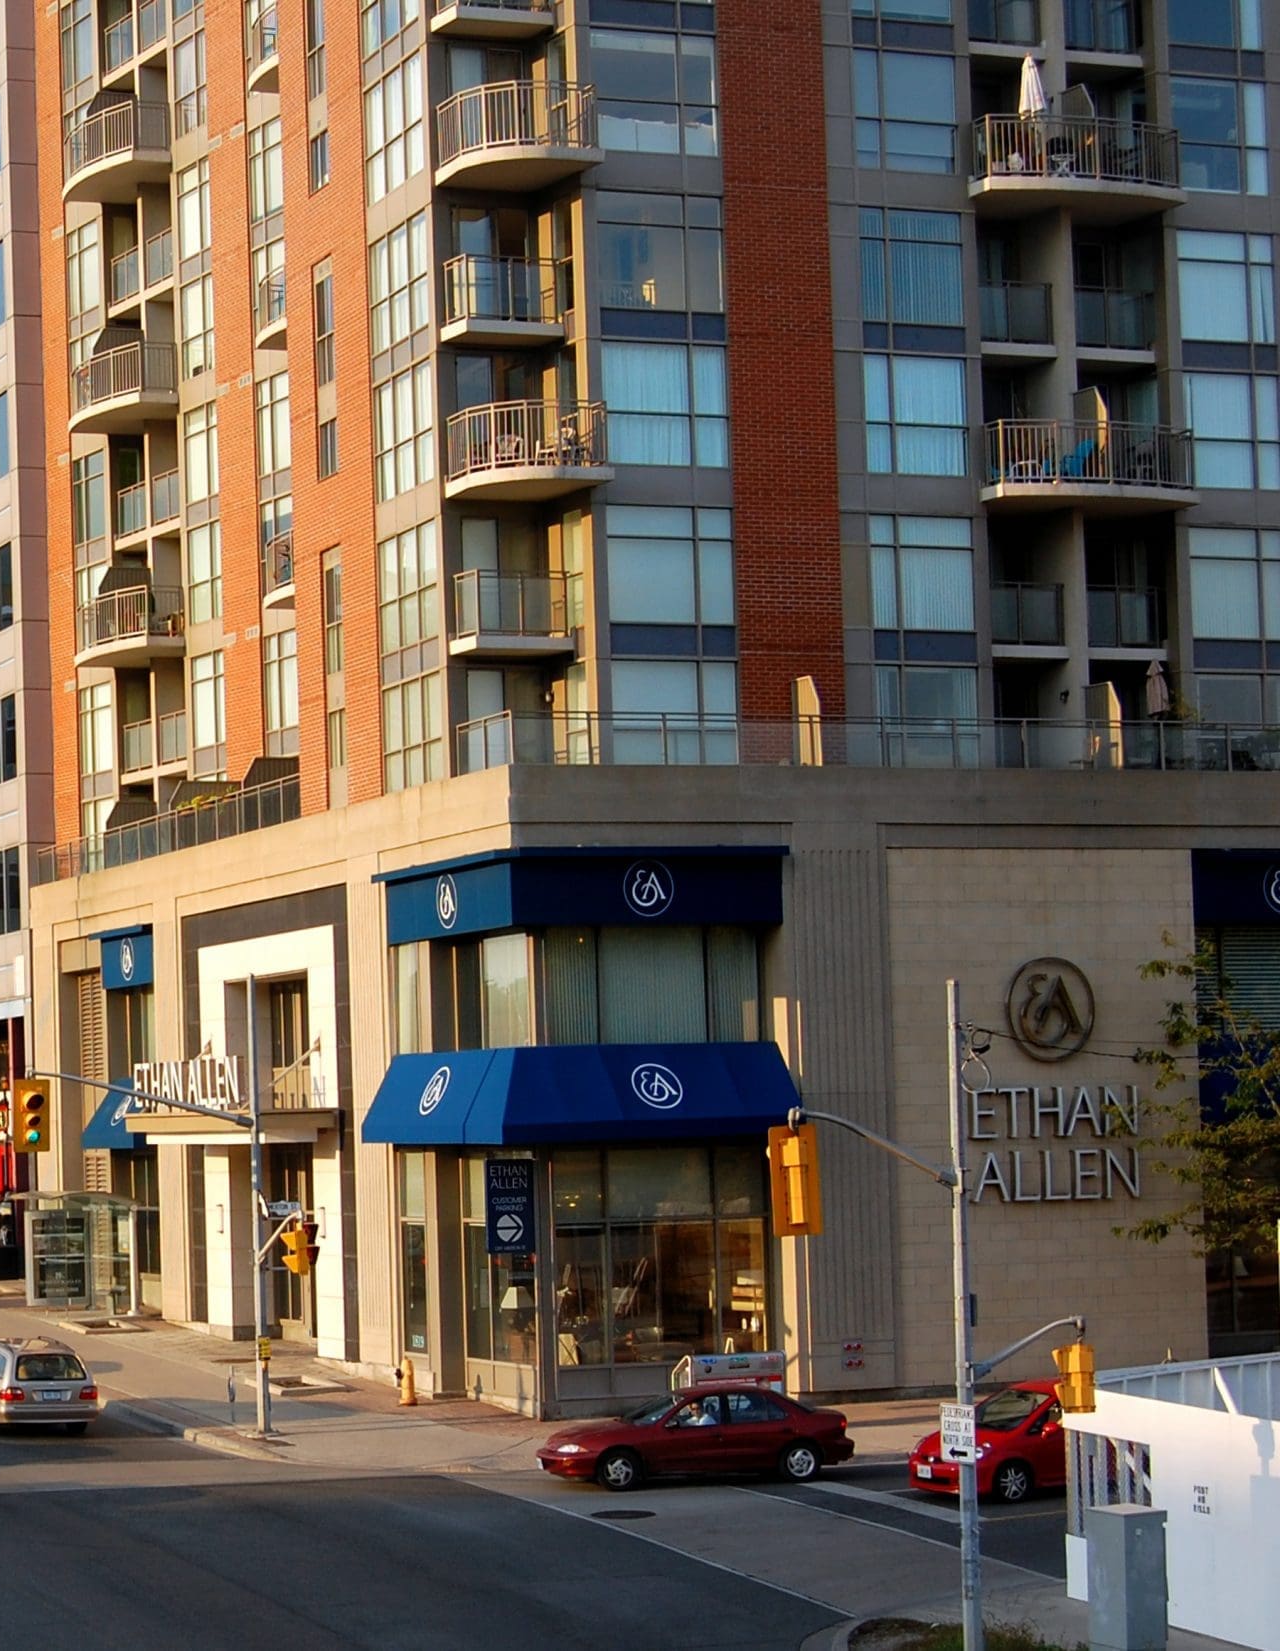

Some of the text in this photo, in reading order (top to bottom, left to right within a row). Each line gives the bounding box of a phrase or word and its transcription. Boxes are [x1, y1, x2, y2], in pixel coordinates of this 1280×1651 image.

[133, 1059, 184, 1108] ETHAN
[187, 1054, 240, 1107] ALLEN
[970, 1085, 1138, 1139] ETHAN
[489, 1165, 528, 1177] ETHAN
[973, 1148, 1140, 1203] ALLEN
[489, 1178, 528, 1189] ALLEN
[491, 1196, 528, 1205] CUSTOMER
[495, 1204, 524, 1212] PARKING
[941, 1406, 974, 1420] PEDESTRIANS
[944, 1420, 972, 1433] CROSS AT
[942, 1434, 974, 1447] NORTH SIDE
[1193, 1485, 1209, 1495] POST
[1198, 1495, 1205, 1504] NO
[1193, 1503, 1210, 1515] BILLS
